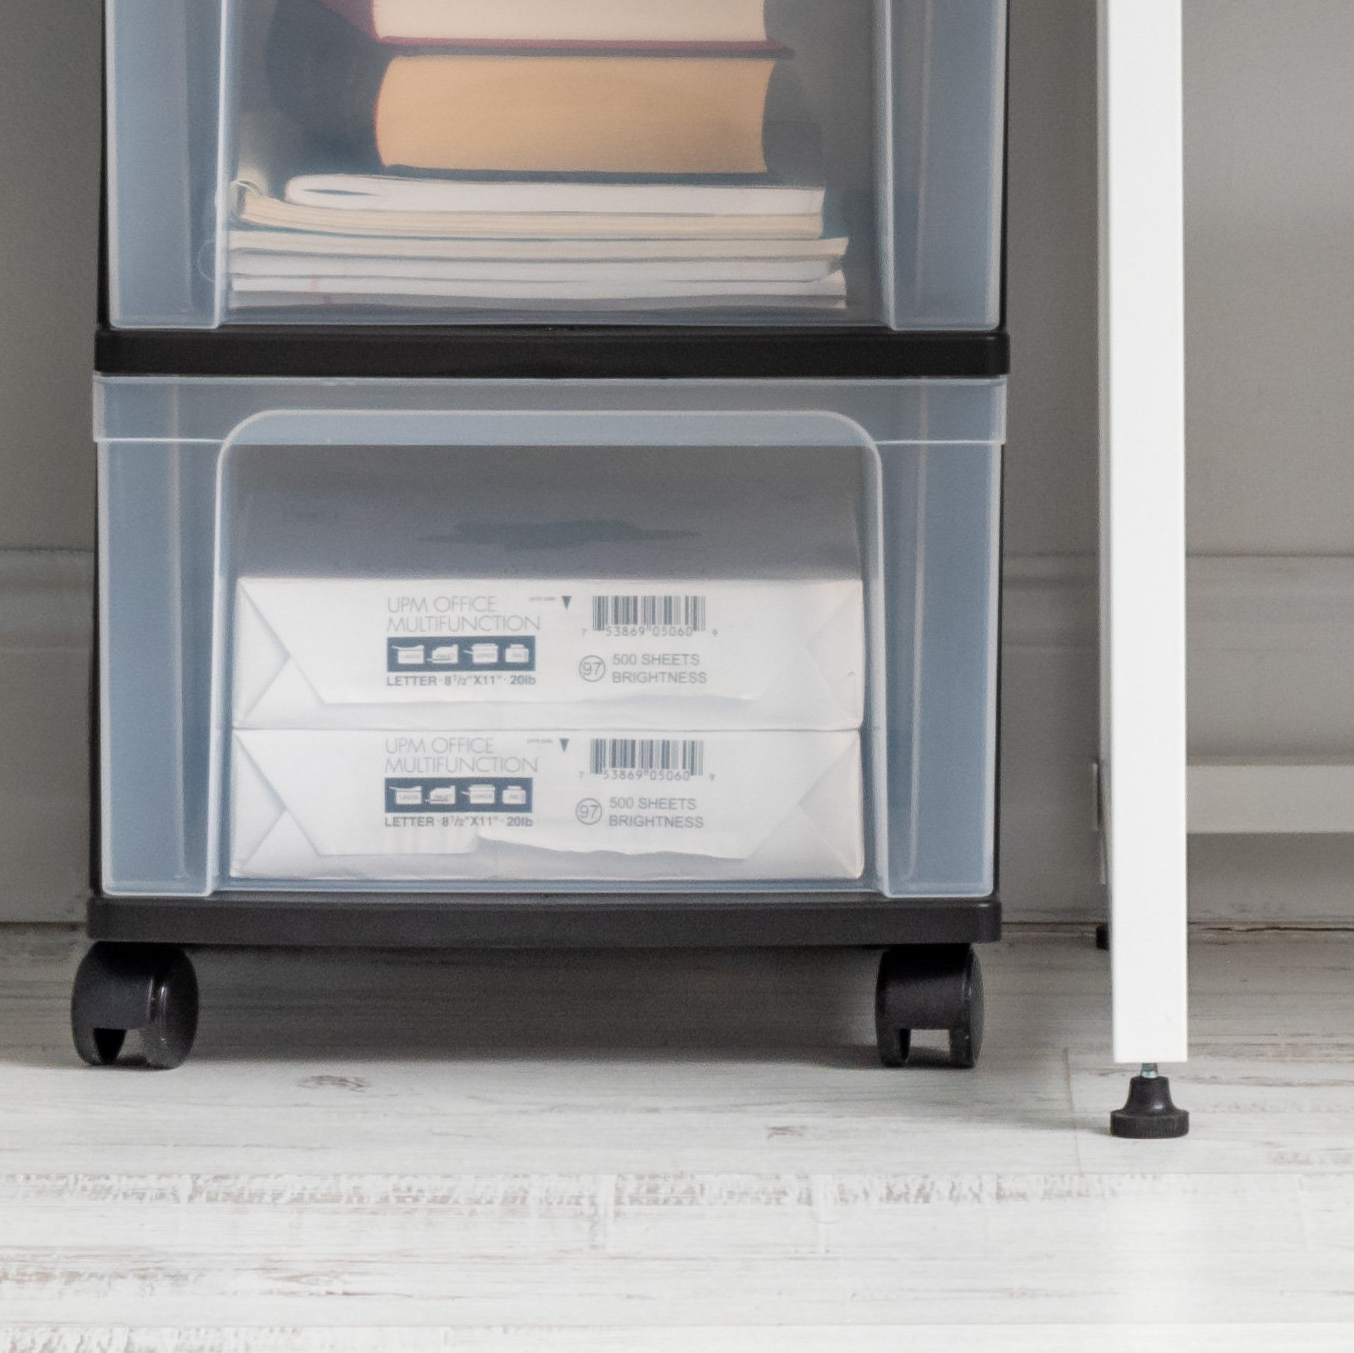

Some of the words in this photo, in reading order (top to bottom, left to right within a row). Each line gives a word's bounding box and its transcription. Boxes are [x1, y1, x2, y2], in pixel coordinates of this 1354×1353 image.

[387, 596, 428, 613] UPM
[433, 595, 496, 613] OFFICE
[387, 615, 541, 632] MULTIFUNCTION
[605, 626, 645, 637] 53869
[652, 626, 693, 637] 05060
[612, 654, 637, 666] 500
[641, 653, 700, 666] SHEETS
[387, 675, 437, 686] LETTER
[510, 674, 537, 686] 20lb
[612, 671, 708, 684] BRIGHTNESS
[385, 737, 426, 754] UPM
[431, 737, 495, 754] OFFICE
[384, 756, 538, 773] MULTIFUNCTION
[603, 770, 643, 781] 53869
[649, 770, 690, 781] 05060
[609, 797, 634, 809] 500
[638, 797, 697, 810] SHEETS
[384, 816, 435, 828] LETTER
[506, 815, 533, 828] 20lb
[609, 815, 704, 828] BRIGHTNESS
